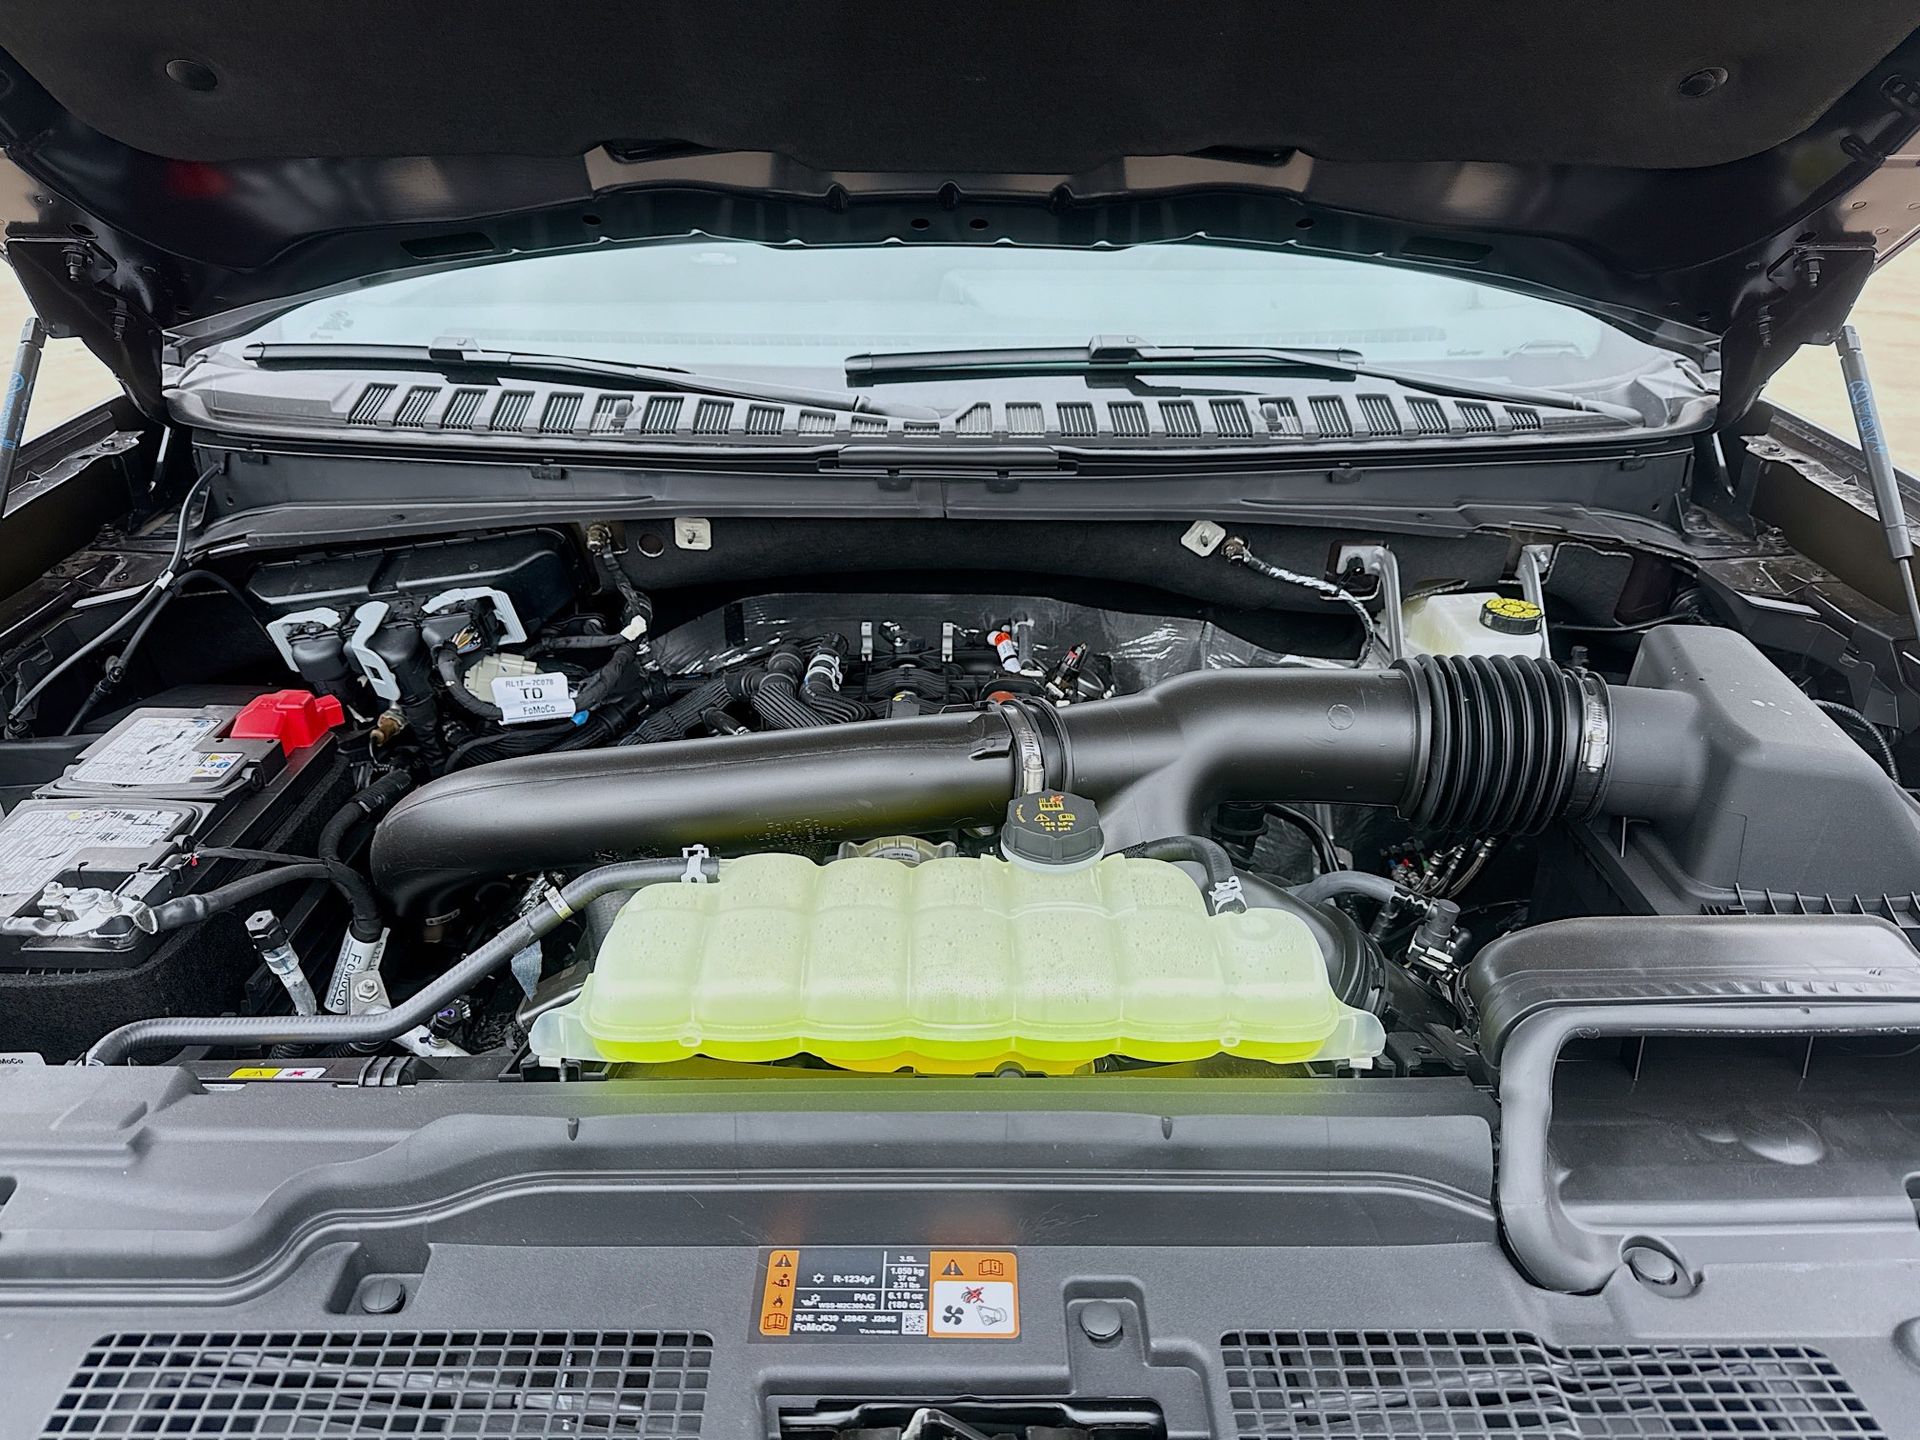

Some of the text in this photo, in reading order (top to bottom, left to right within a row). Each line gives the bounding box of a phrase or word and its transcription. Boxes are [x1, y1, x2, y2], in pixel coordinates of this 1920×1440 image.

[523, 705, 556, 715] FoMoCo
[890, 1267, 925, 1277] 1.050 kg
[832, 1274, 876, 1285] R-1234yf
[853, 1293, 877, 1302] PAG
[888, 1292, 902, 1300] 6.1
[909, 1301, 925, 1310] cc)
[795, 1314, 815, 1322] SAE
[793, 1323, 837, 1332] FoMoCo
